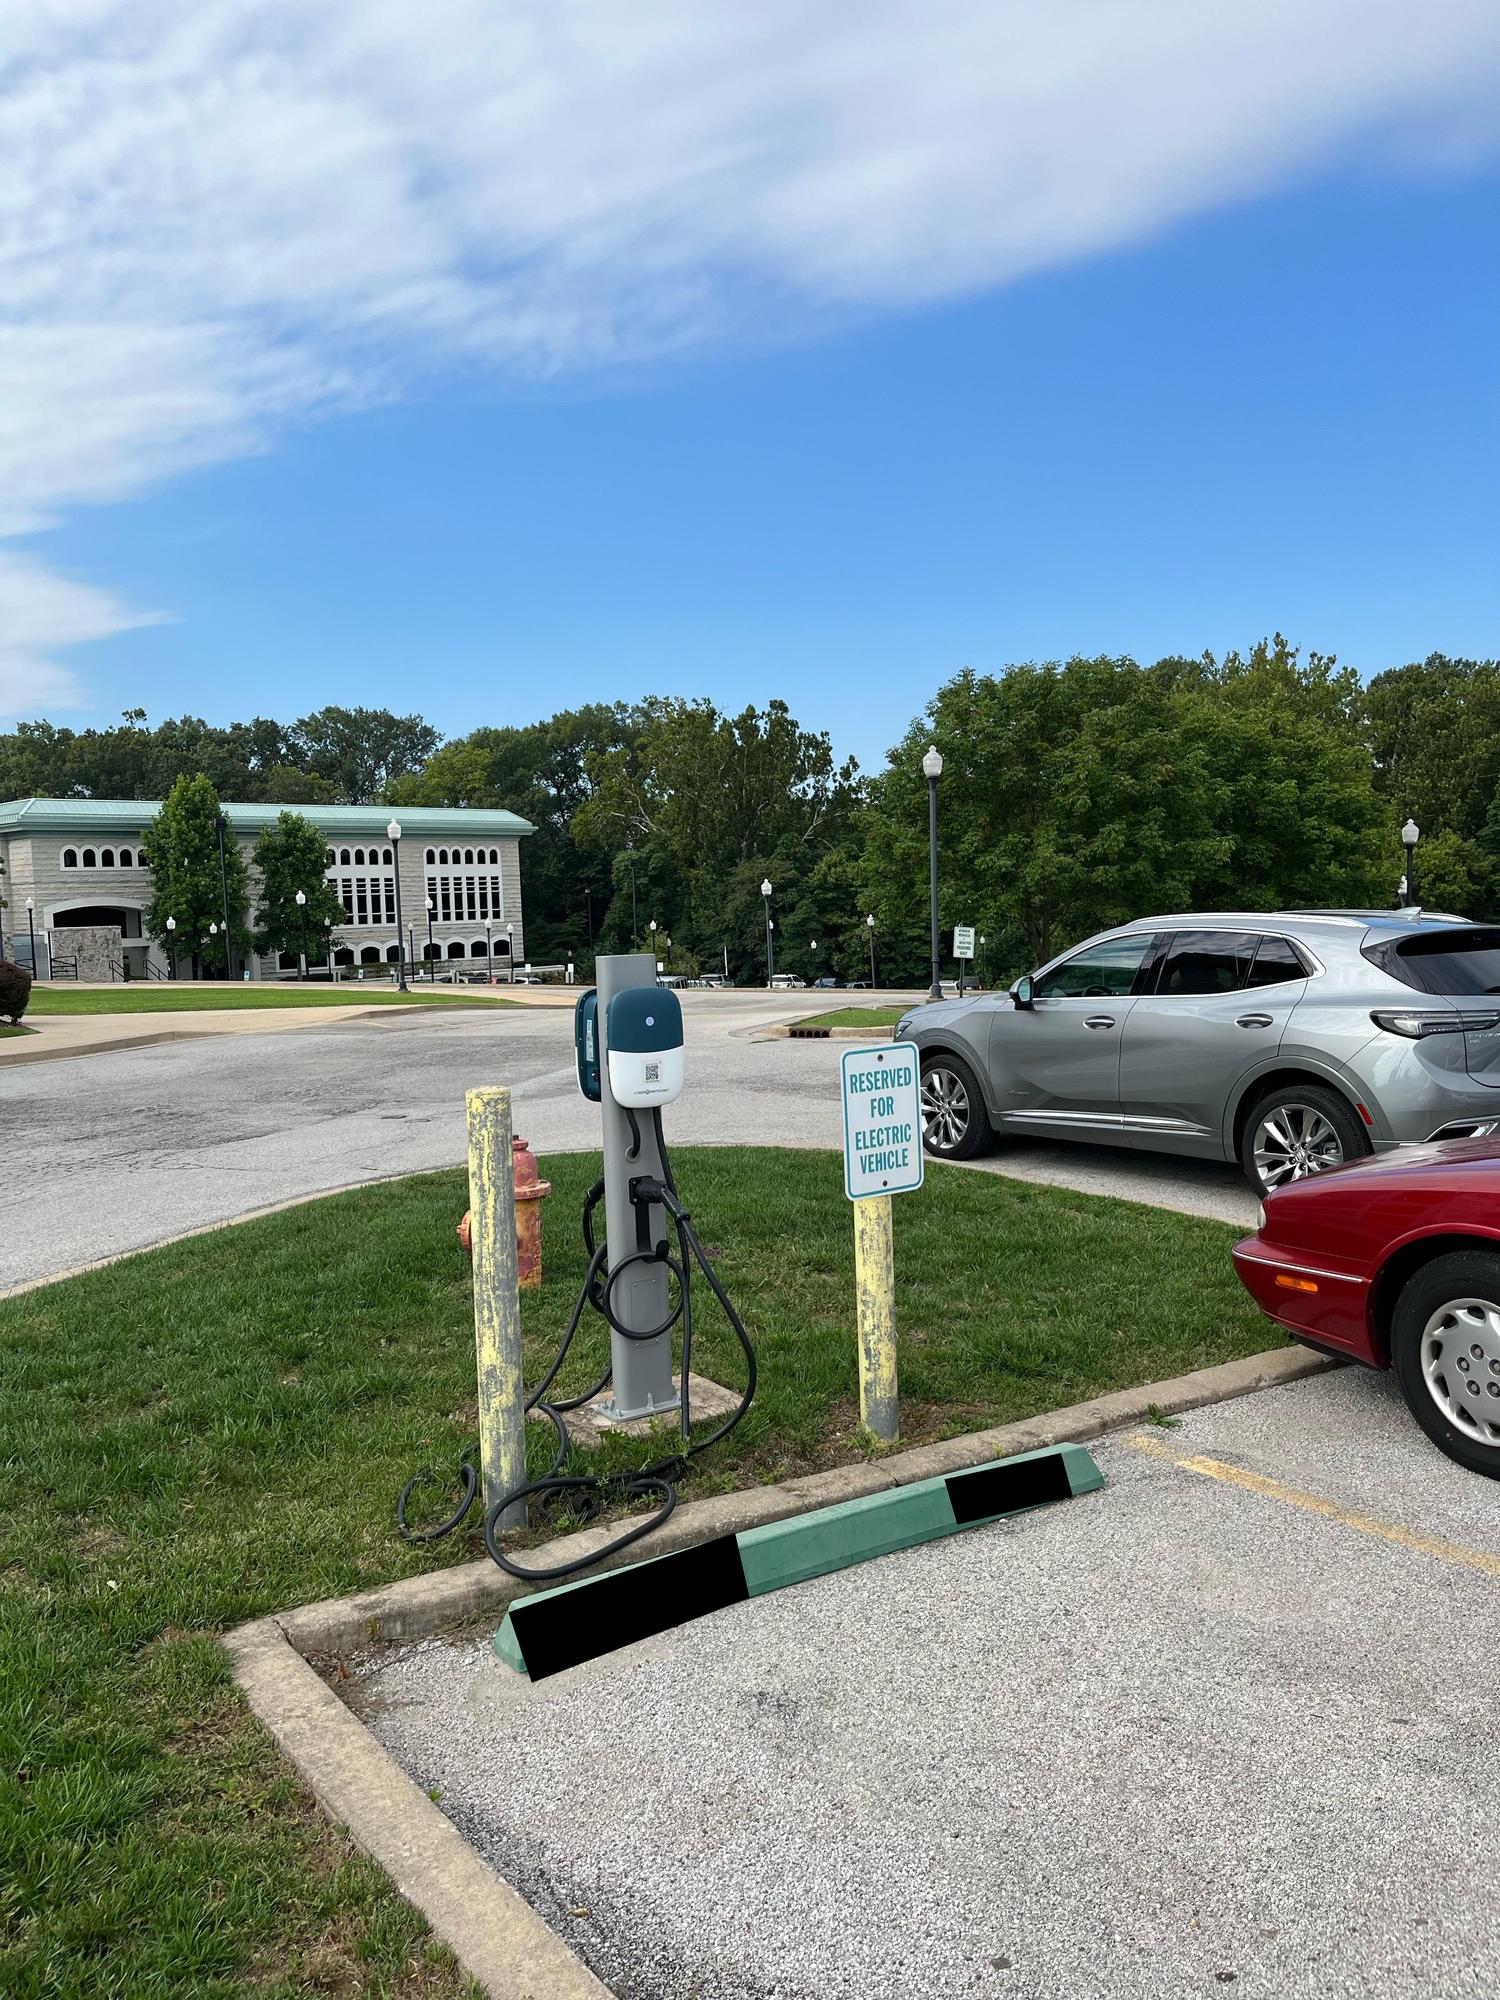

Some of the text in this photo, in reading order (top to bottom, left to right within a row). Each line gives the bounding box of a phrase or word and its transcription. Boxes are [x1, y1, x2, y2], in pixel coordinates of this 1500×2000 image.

[850, 1067, 912, 1094] RESERVED
[870, 1096, 894, 1118] FOR
[855, 1123, 912, 1150] ELECTRIC
[860, 1148, 908, 1174] VEHICLE
